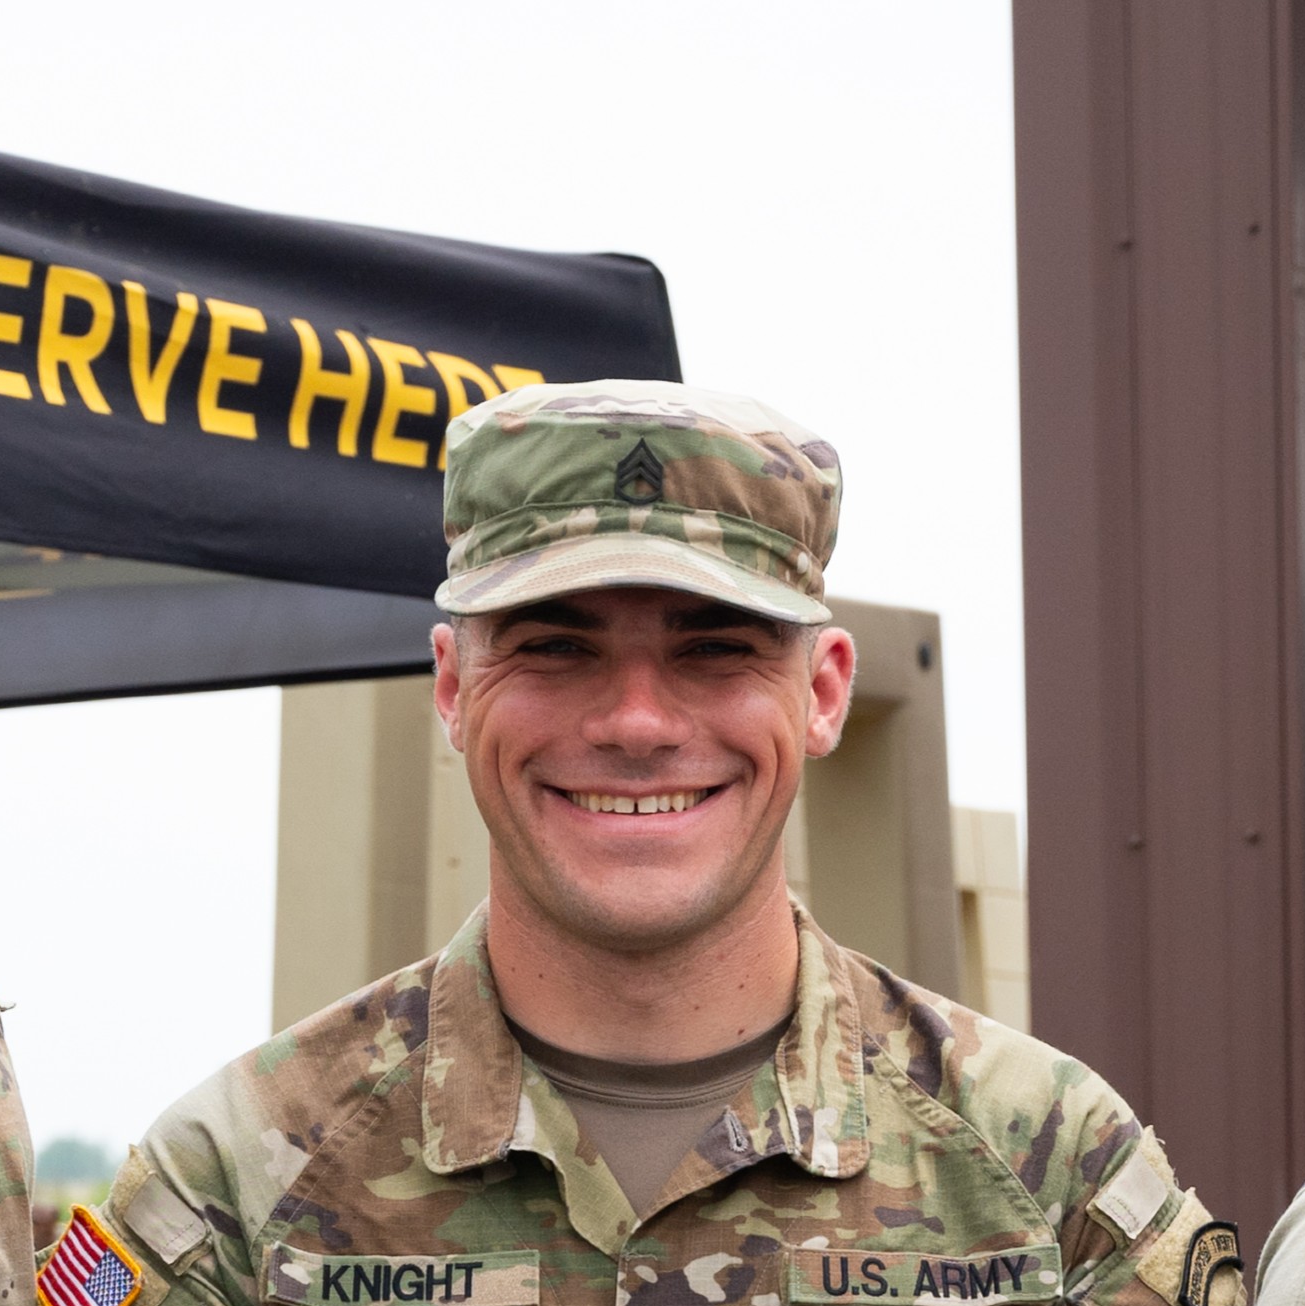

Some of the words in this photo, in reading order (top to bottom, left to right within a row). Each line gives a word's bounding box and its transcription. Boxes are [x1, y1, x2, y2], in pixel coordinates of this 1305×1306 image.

[288, 317, 546, 472] HER
[322, 1261, 484, 1302] KNIGHT
[821, 1255, 899, 1298] U.S.
[913, 1254, 1029, 1300] ARMY
